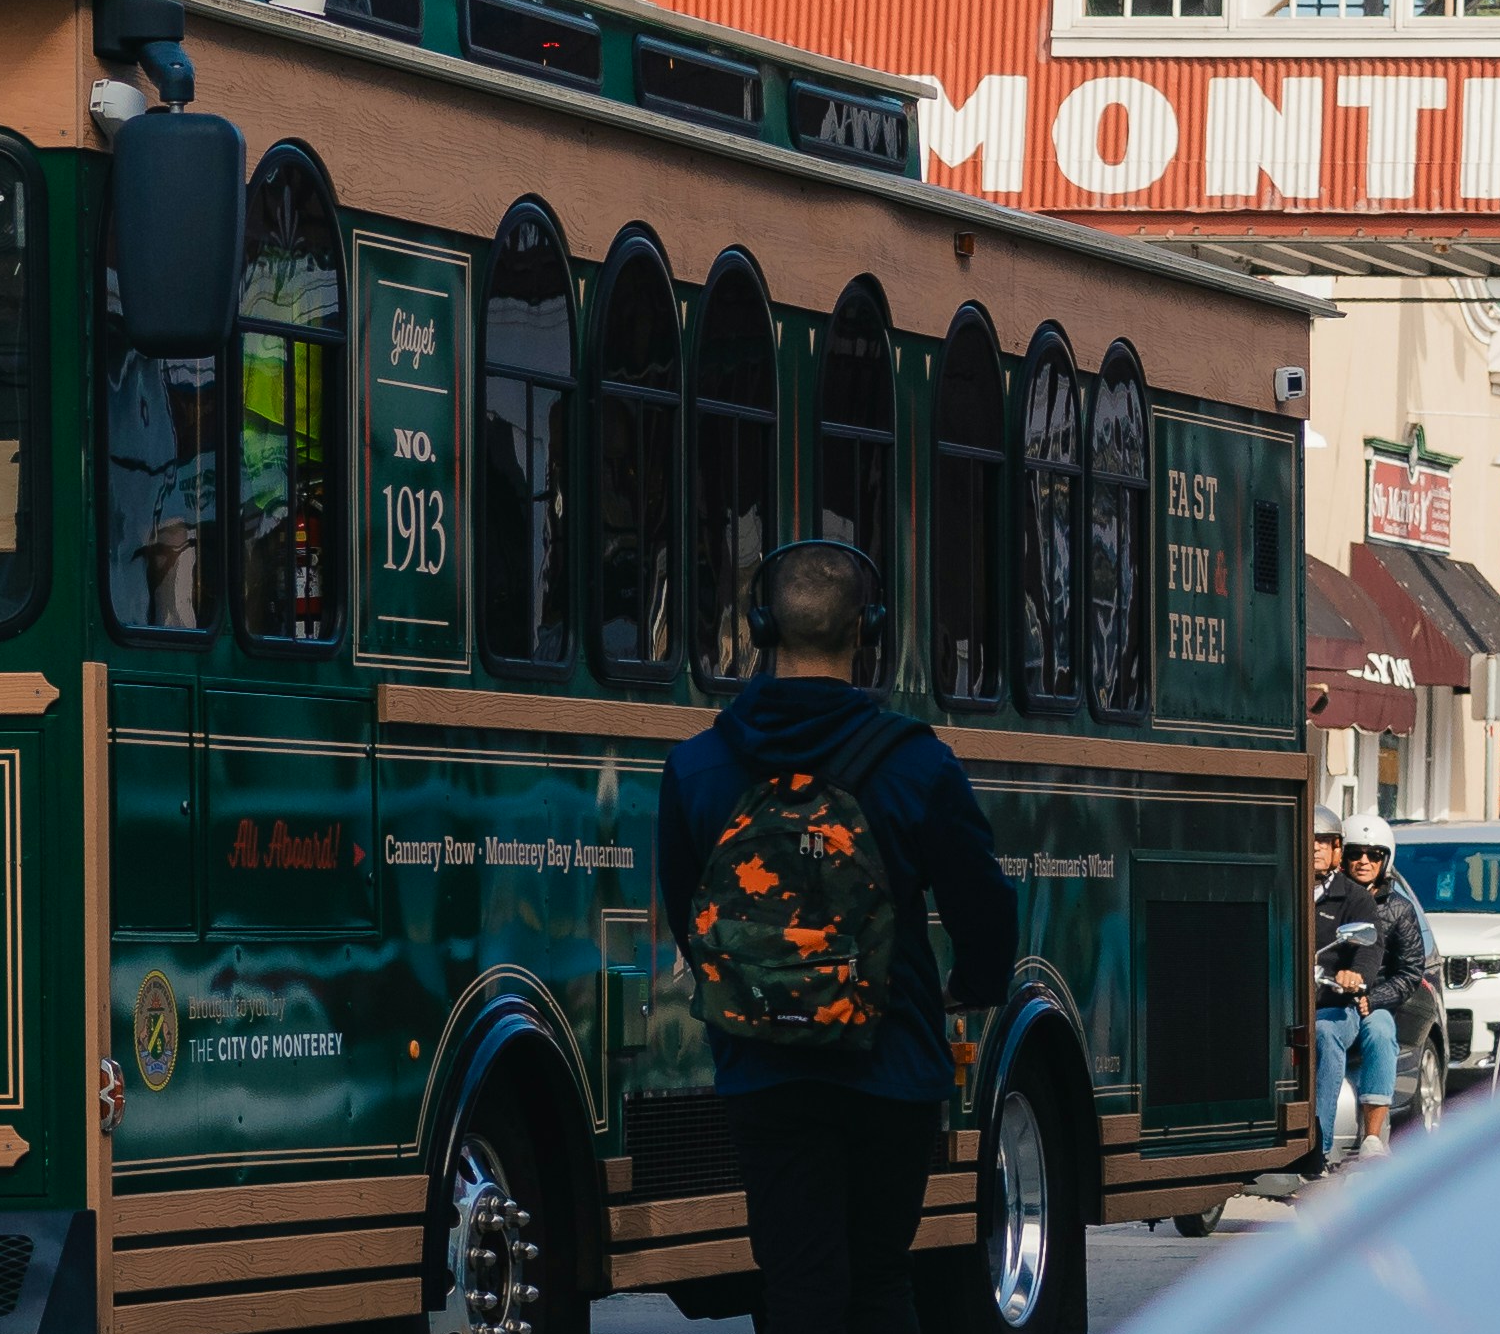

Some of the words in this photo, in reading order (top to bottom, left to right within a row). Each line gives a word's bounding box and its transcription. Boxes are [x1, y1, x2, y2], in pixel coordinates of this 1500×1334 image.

[391, 307, 435, 369] Gidget
[393, 428, 436, 462] NO.
[1168, 469, 1217, 522] FAST
[382, 484, 446, 575] 1913
[1168, 544, 1209, 594] FUN
[1214, 550, 1228, 597] &
[1168, 612, 1225, 665] FREE!
[385, 835, 442, 872] Cannery
[444, 835, 475, 865] Row
[485, 836, 546, 873] Monterey
[547, 838, 571, 874] Bay
[574, 838, 634, 875] Aquarium
[1033, 852, 1087, 877] Fisherman's
[188, 996, 233, 1024] Brought
[235, 997, 247, 1017] to
[247, 999, 270, 1022] you
[271, 992, 286, 1021] by
[189, 1038, 215, 1063] THE
[218, 1036, 247, 1061] CITY
[251, 1035, 269, 1059] OF
[273, 1032, 343, 1058] MONTEREY
